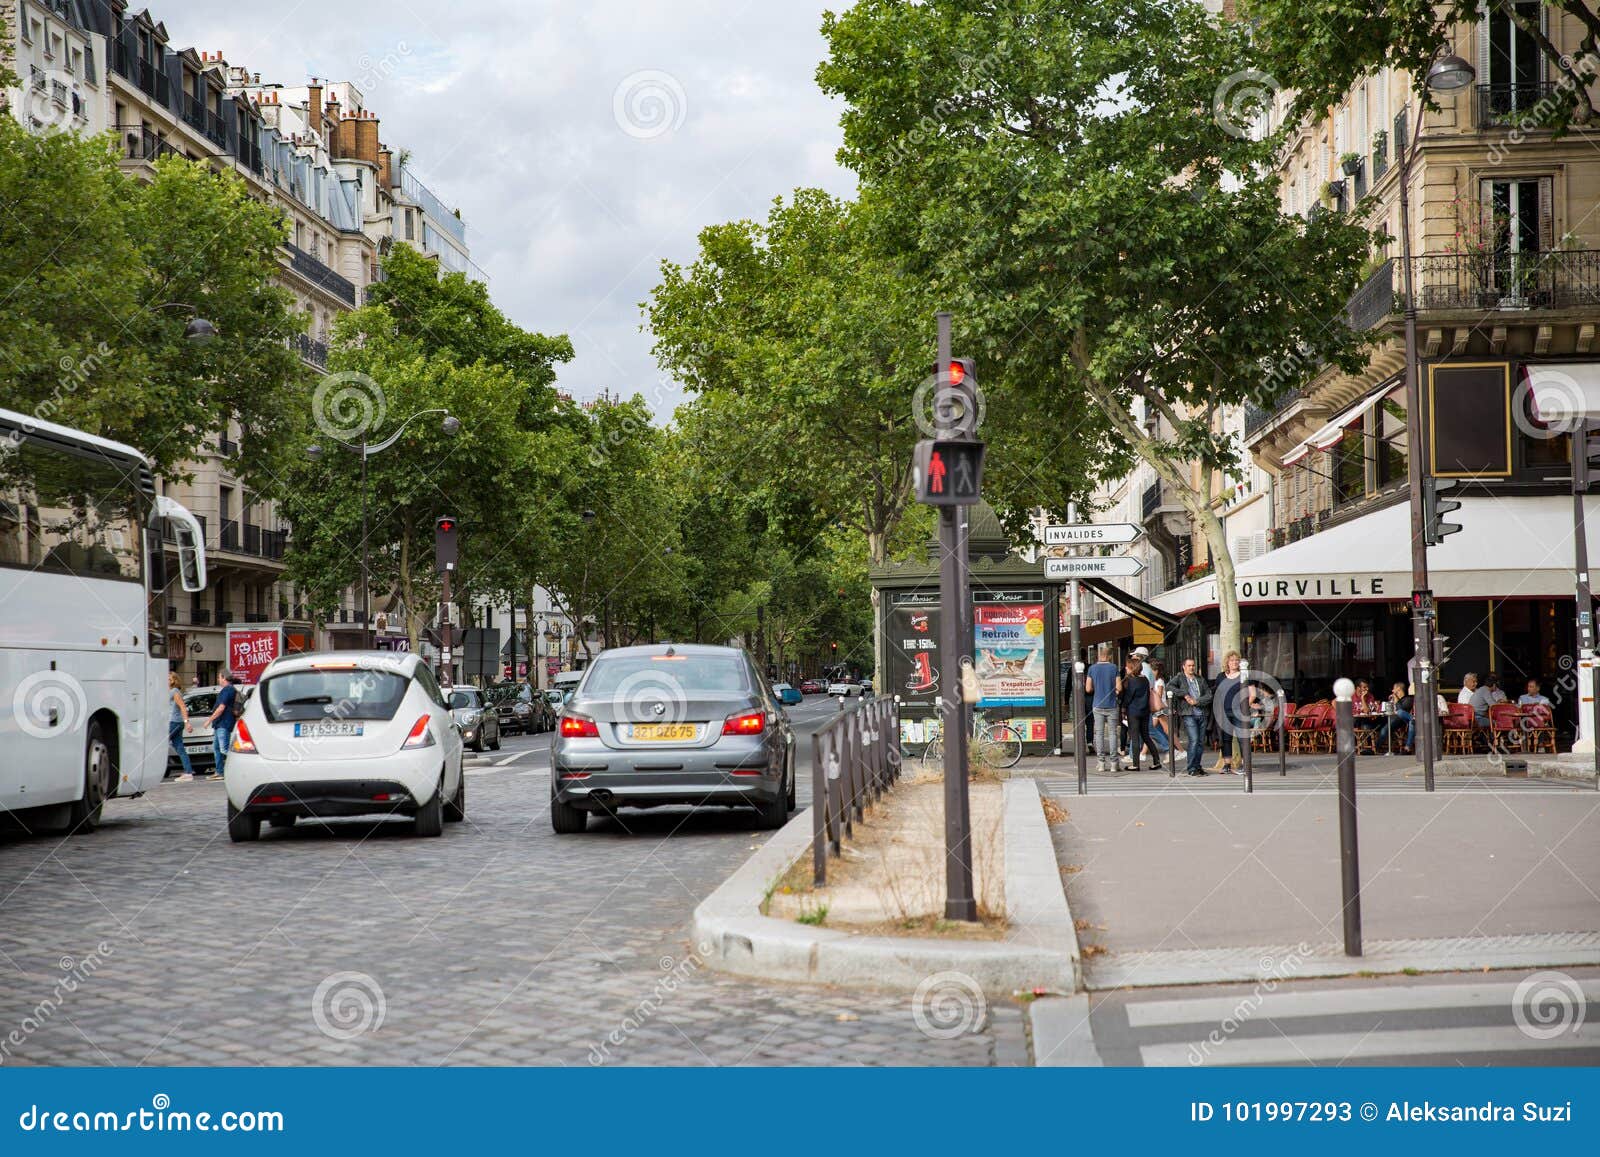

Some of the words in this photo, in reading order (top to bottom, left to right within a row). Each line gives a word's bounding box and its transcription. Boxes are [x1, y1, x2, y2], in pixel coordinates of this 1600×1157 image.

[1049, 530, 1104, 540] INVALIDES
[1050, 563, 1106, 573] CAMBRONNE
[1234, 578, 1384, 599] OURVILLE
[982, 629, 1020, 638] Retraite
[247, 650, 273, 666] PARIS
[679, 726, 693, 738] 75
